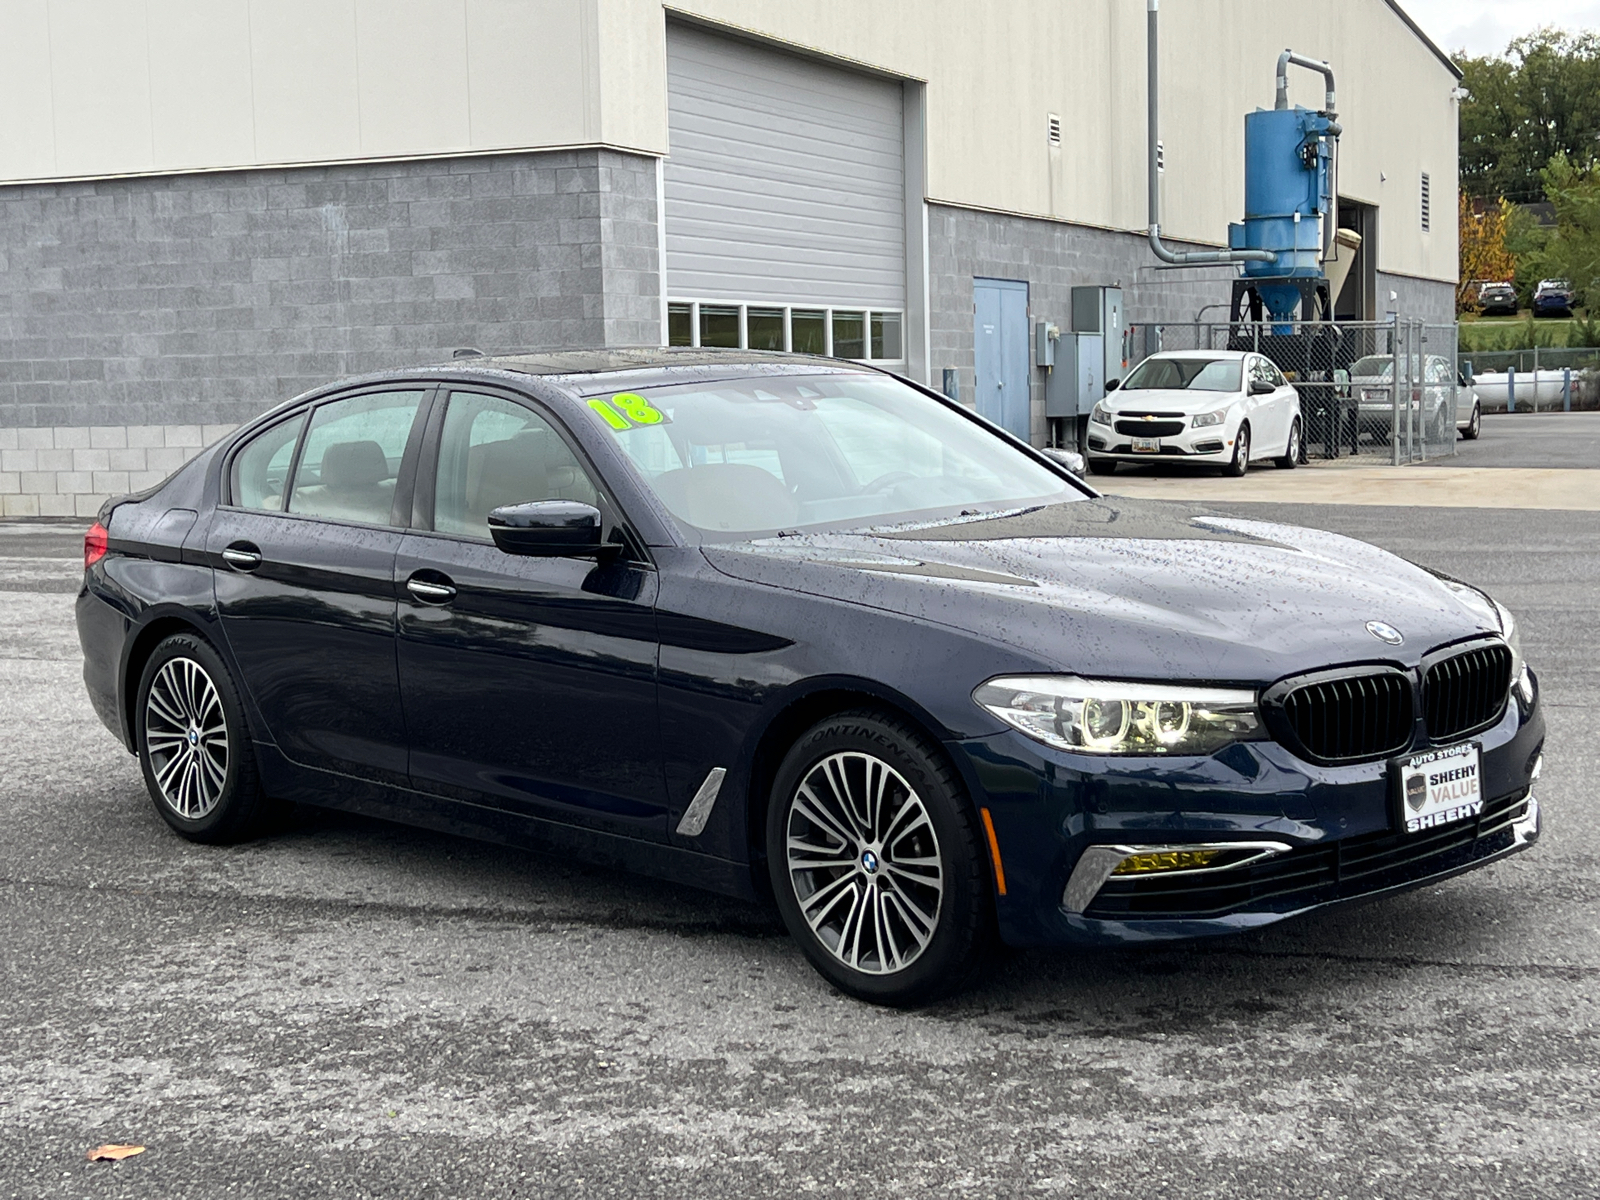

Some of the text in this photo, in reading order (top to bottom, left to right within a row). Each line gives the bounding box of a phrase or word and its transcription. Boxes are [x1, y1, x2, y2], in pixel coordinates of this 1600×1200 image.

[586, 391, 664, 430] 18
[801, 725, 936, 794] CONTINENTAL
[1409, 743, 1473, 767] AUTO STORES
[1430, 764, 1476, 786] SHEEHY
[1431, 778, 1478, 804] VALUE
[1407, 800, 1484, 833] SHEEHY
